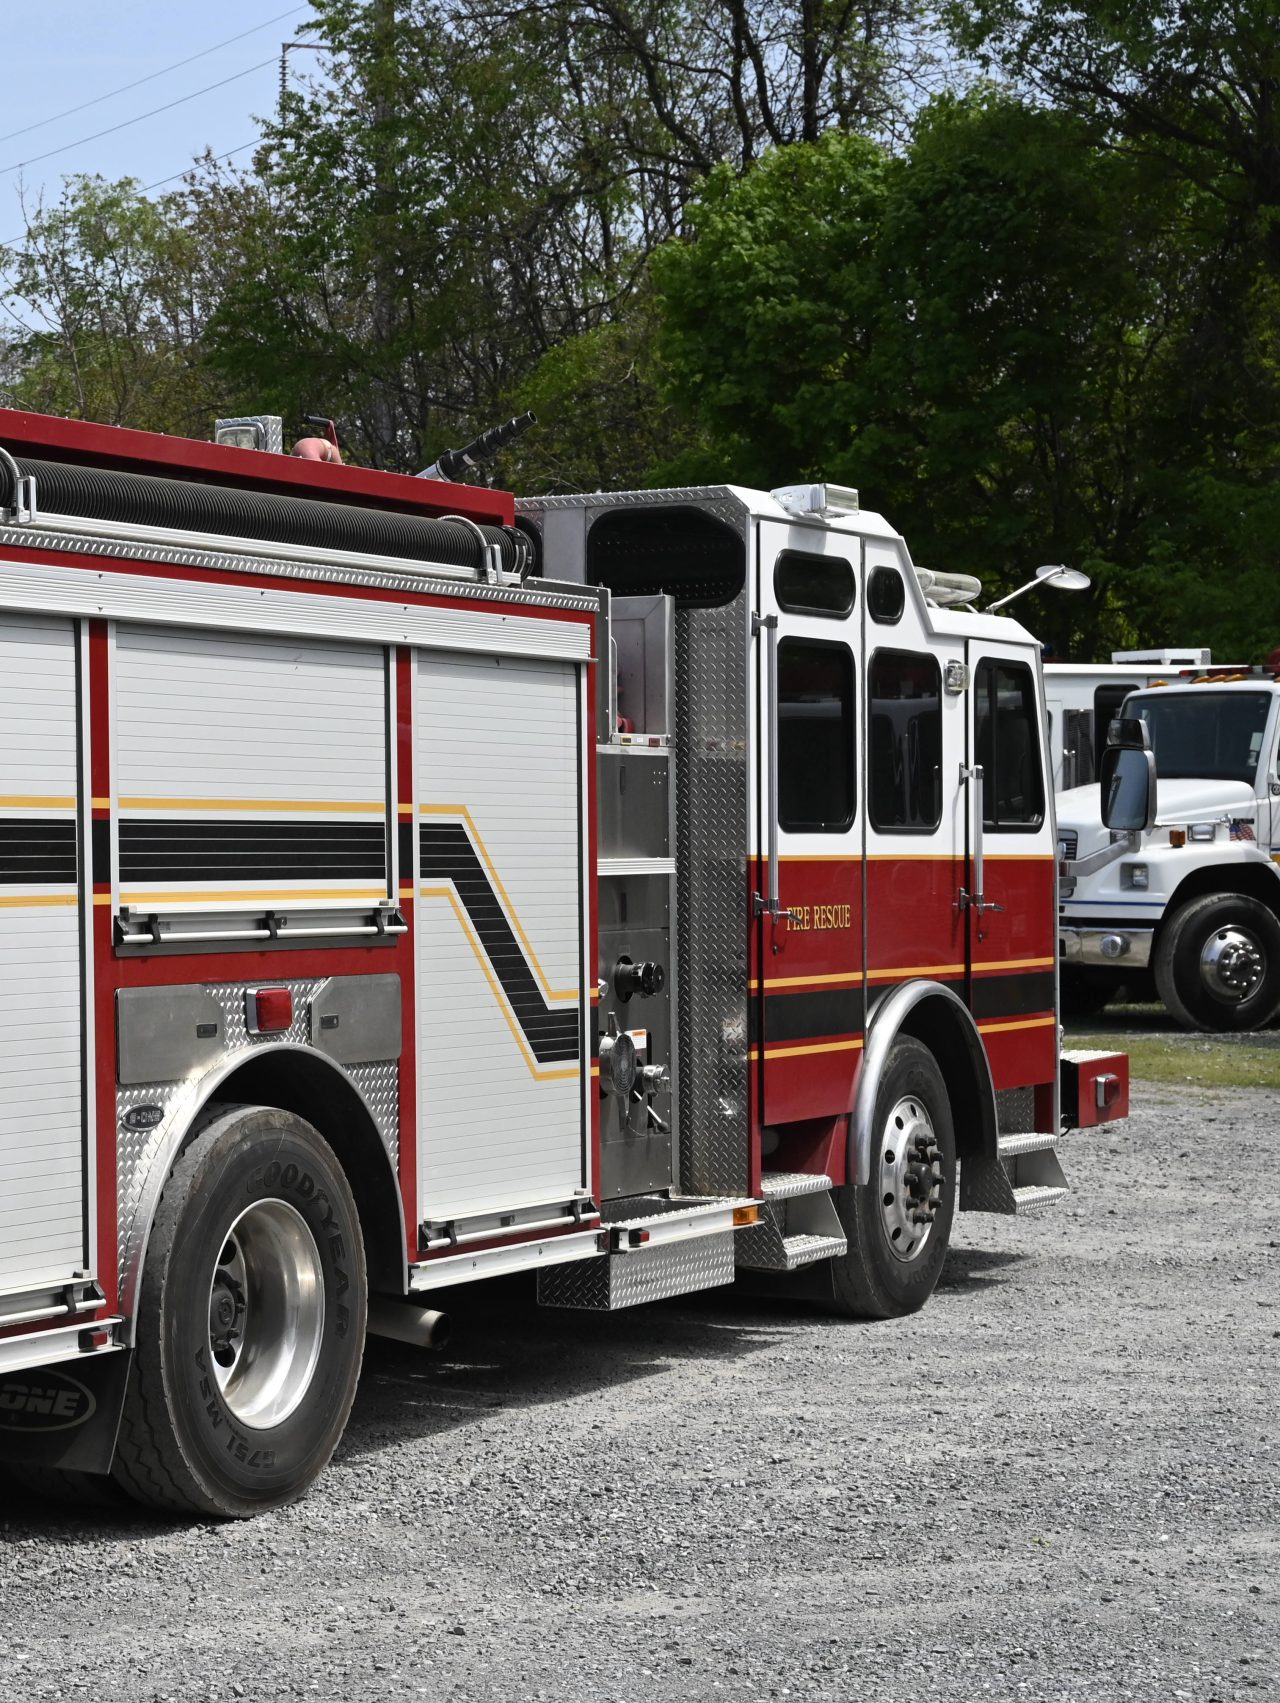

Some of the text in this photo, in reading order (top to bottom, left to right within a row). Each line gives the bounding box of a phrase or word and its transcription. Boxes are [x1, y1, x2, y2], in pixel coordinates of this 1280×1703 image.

[786, 905, 851, 931] FIRE RESCUE
[246, 1160, 350, 1339] GOODYEAR
